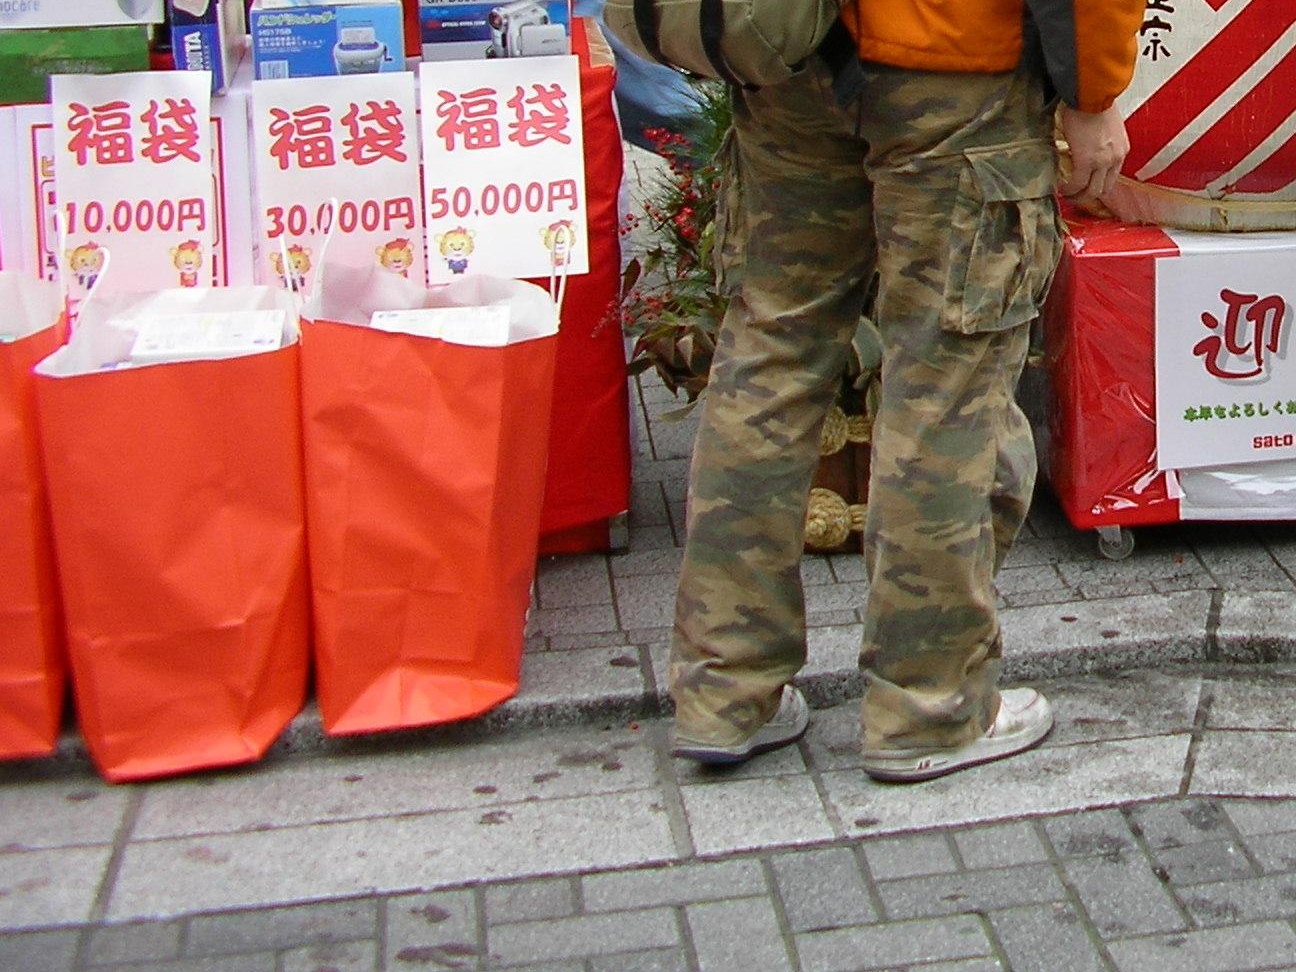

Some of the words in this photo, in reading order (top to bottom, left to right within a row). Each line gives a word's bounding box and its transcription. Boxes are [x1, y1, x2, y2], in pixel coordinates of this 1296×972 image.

[67, 98, 202, 166] 福袋
[269, 100, 409, 171] 福袋
[436, 83, 573, 152] 福袋
[1253, 434, 1292, 449] sato
